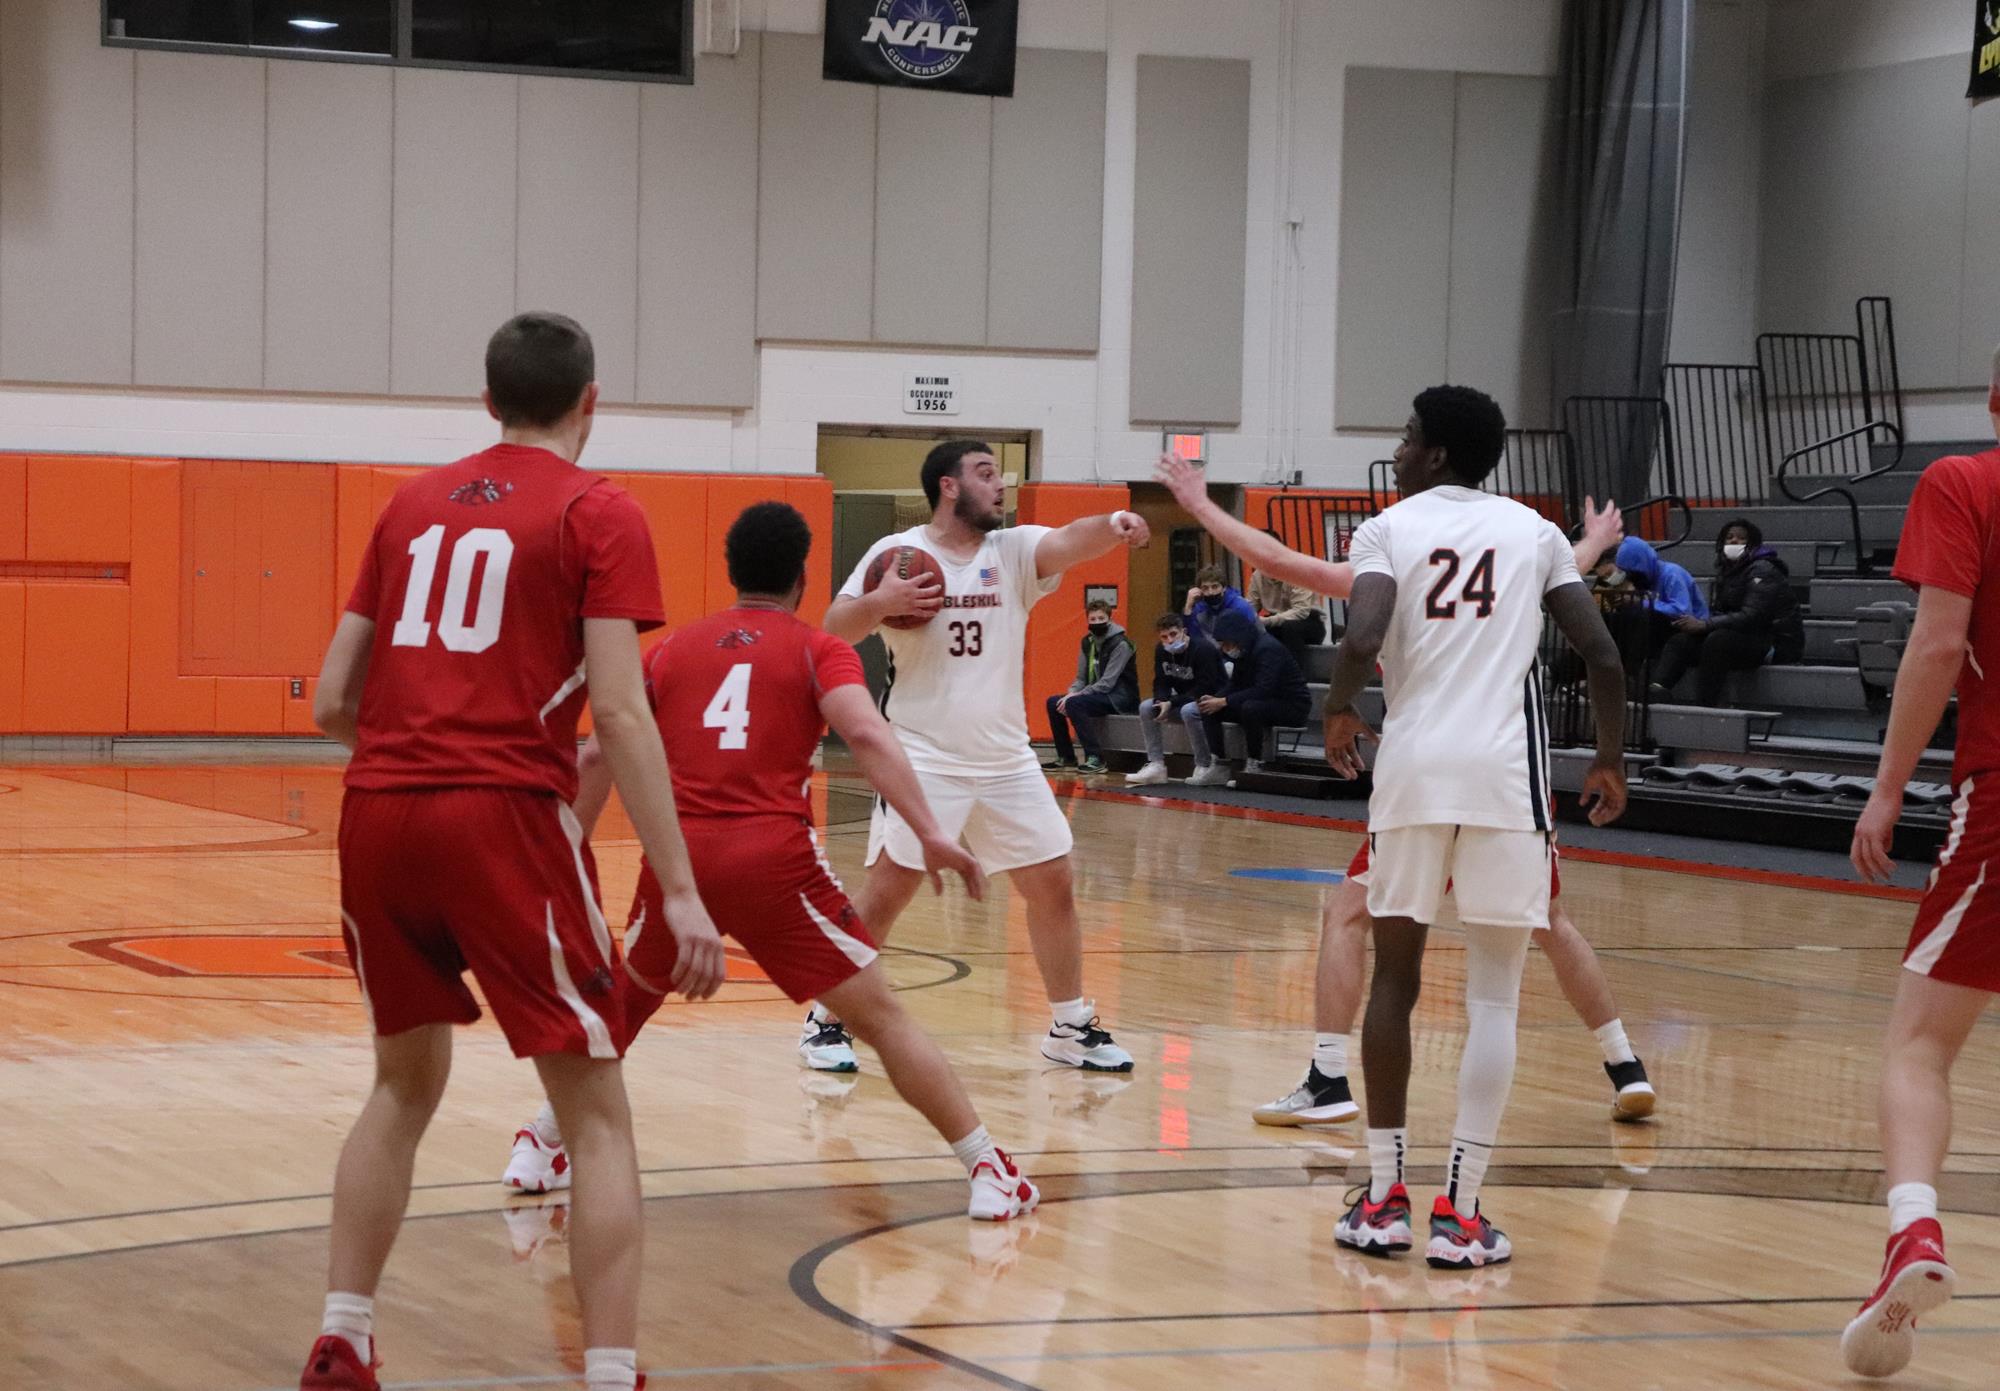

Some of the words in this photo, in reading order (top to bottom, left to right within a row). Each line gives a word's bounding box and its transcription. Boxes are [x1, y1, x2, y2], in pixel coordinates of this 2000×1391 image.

[861, 17, 979, 52] NAC
[887, 48, 957, 75] CONFERENCE
[910, 390, 953, 399] OCCUPANCY
[915, 377, 949, 385] MAXIMUM
[916, 399, 947, 411] 1956
[391, 524, 515, 654] 10
[1425, 547, 1497, 620] 24
[943, 592, 1003, 609] BLESKIL
[948, 620, 983, 658] 33
[703, 663, 752, 750] 4
